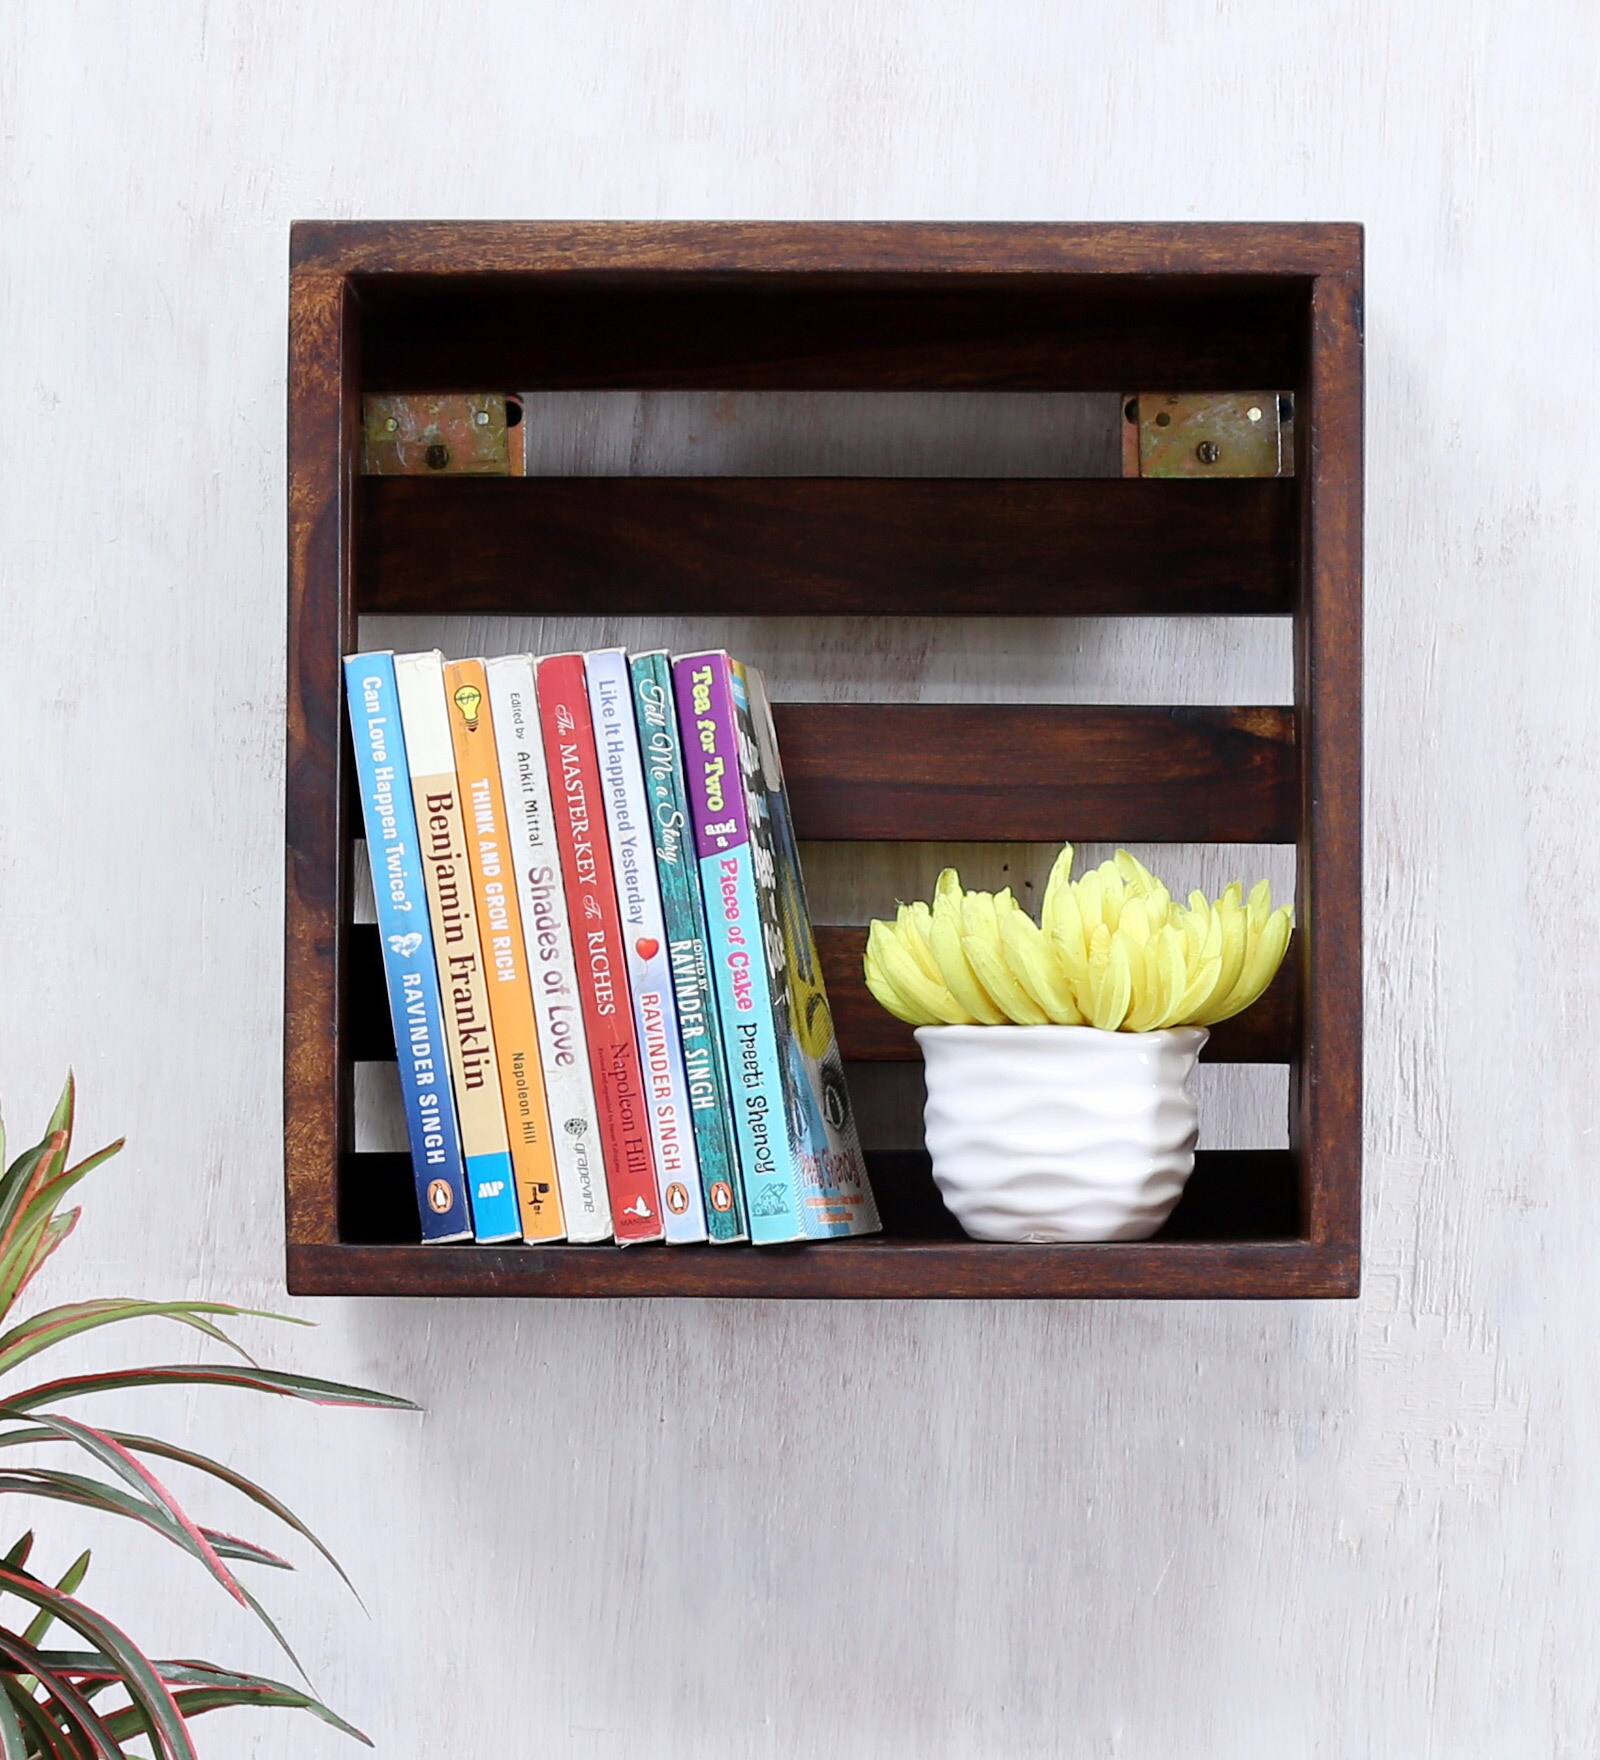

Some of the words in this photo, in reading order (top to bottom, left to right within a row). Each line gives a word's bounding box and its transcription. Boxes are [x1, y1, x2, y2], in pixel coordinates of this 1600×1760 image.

[362, 676, 382, 713] Can
[510, 692, 523, 726] Edited
[599, 680, 618, 718] Like
[639, 678, 666, 726] Tell
[692, 665, 713, 715] Tea
[368, 717, 387, 762] Love
[515, 726, 525, 740] by
[554, 704, 574, 737] The
[604, 723, 621, 736] It
[697, 720, 717, 754] for
[517, 752, 533, 793] Ankit
[648, 733, 674, 780] Me
[373, 766, 398, 839] Happen
[471, 778, 495, 835] THINK
[606, 741, 635, 831] Happened
[656, 786, 668, 797] a
[704, 757, 725, 812] Two
[524, 800, 544, 847] Mittal
[560, 743, 598, 885] MASTER-KEY
[656, 802, 684, 865] Story
[704, 819, 737, 835] and
[479, 841, 501, 877] AND
[716, 836, 728, 848] a
[386, 842, 412, 911] Twice?
[620, 836, 645, 924] Yesterday
[720, 857, 740, 920] Piece
[485, 882, 509, 930] GROW
[528, 866, 561, 961] Shades
[583, 894, 602, 920] To
[426, 791, 470, 945] Benjamin
[449, 952, 491, 1090] Franklin
[492, 936, 516, 982] RICH
[728, 926, 746, 945] of
[543, 970, 571, 995] of
[587, 930, 615, 1016] RICHES
[670, 940, 704, 1040] RAVINDER
[693, 939, 705, 976] EDITED
[699, 979, 708, 991] BY
[727, 951, 753, 1010] Cake
[548, 1005, 575, 1067] Love
[737, 1022, 764, 1088] Preeti
[402, 973, 435, 1086] RAVINDER
[419, 1094, 446, 1164] SINGH
[641, 994, 672, 1098] RAVINDER
[657, 1105, 681, 1170] SINGH
[685, 1050, 715, 1110] SINGH
[512, 1052, 530, 1116] Napoleon
[522, 1121, 537, 1145] Hill
[608, 1042, 636, 1132] Napoleon
[625, 1137, 647, 1173] Hill
[746, 1095, 776, 1173] Shenoy
[574, 1142, 595, 1213] grapevine
